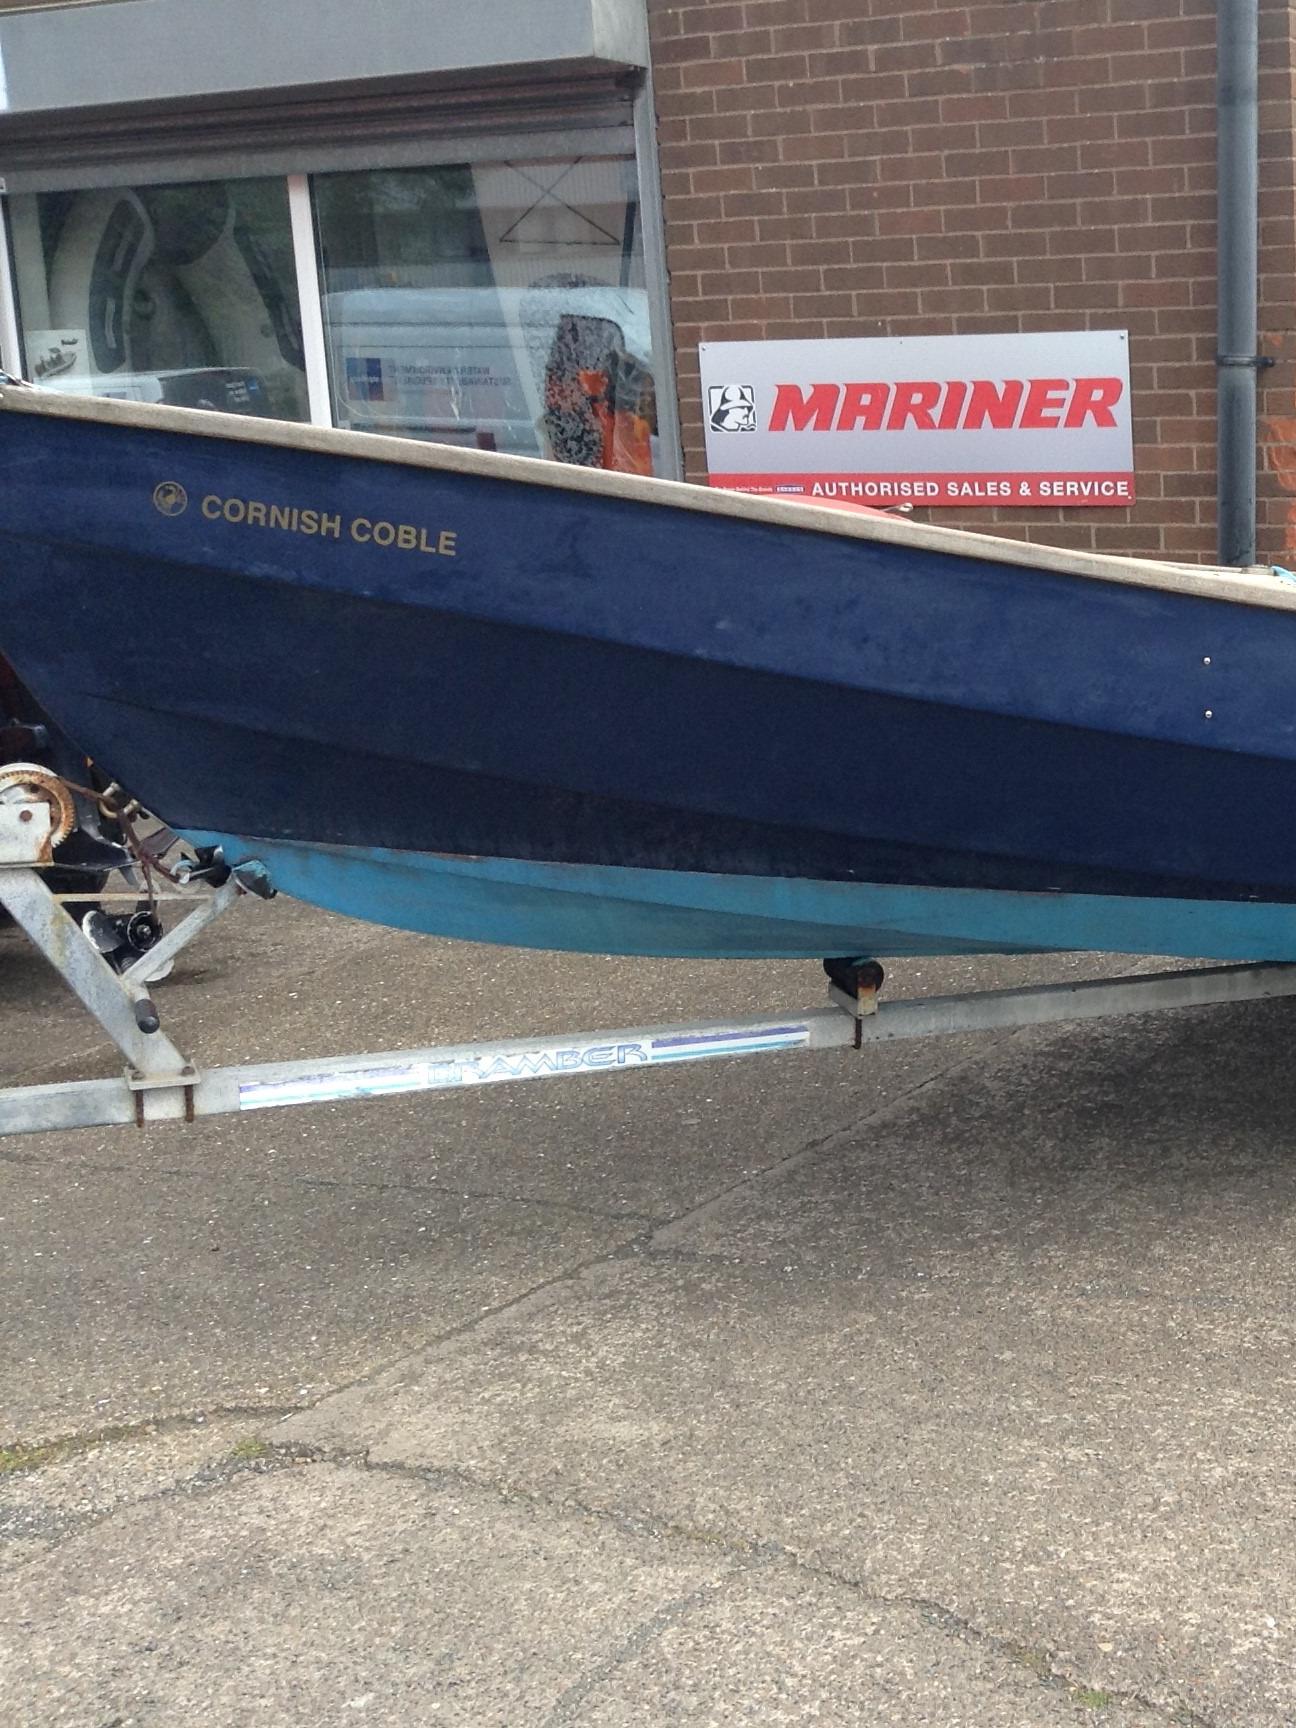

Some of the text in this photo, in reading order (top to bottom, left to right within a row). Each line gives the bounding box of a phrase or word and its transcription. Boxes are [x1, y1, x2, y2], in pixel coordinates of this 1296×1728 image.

[768, 377, 1123, 432] MARINER
[811, 481, 940, 497] AUTHORISED
[947, 481, 1012, 496] SALES
[1019, 481, 1032, 496] &
[1039, 480, 1129, 496] SERVICE
[201, 494, 458, 556] CORNISH COBLE
